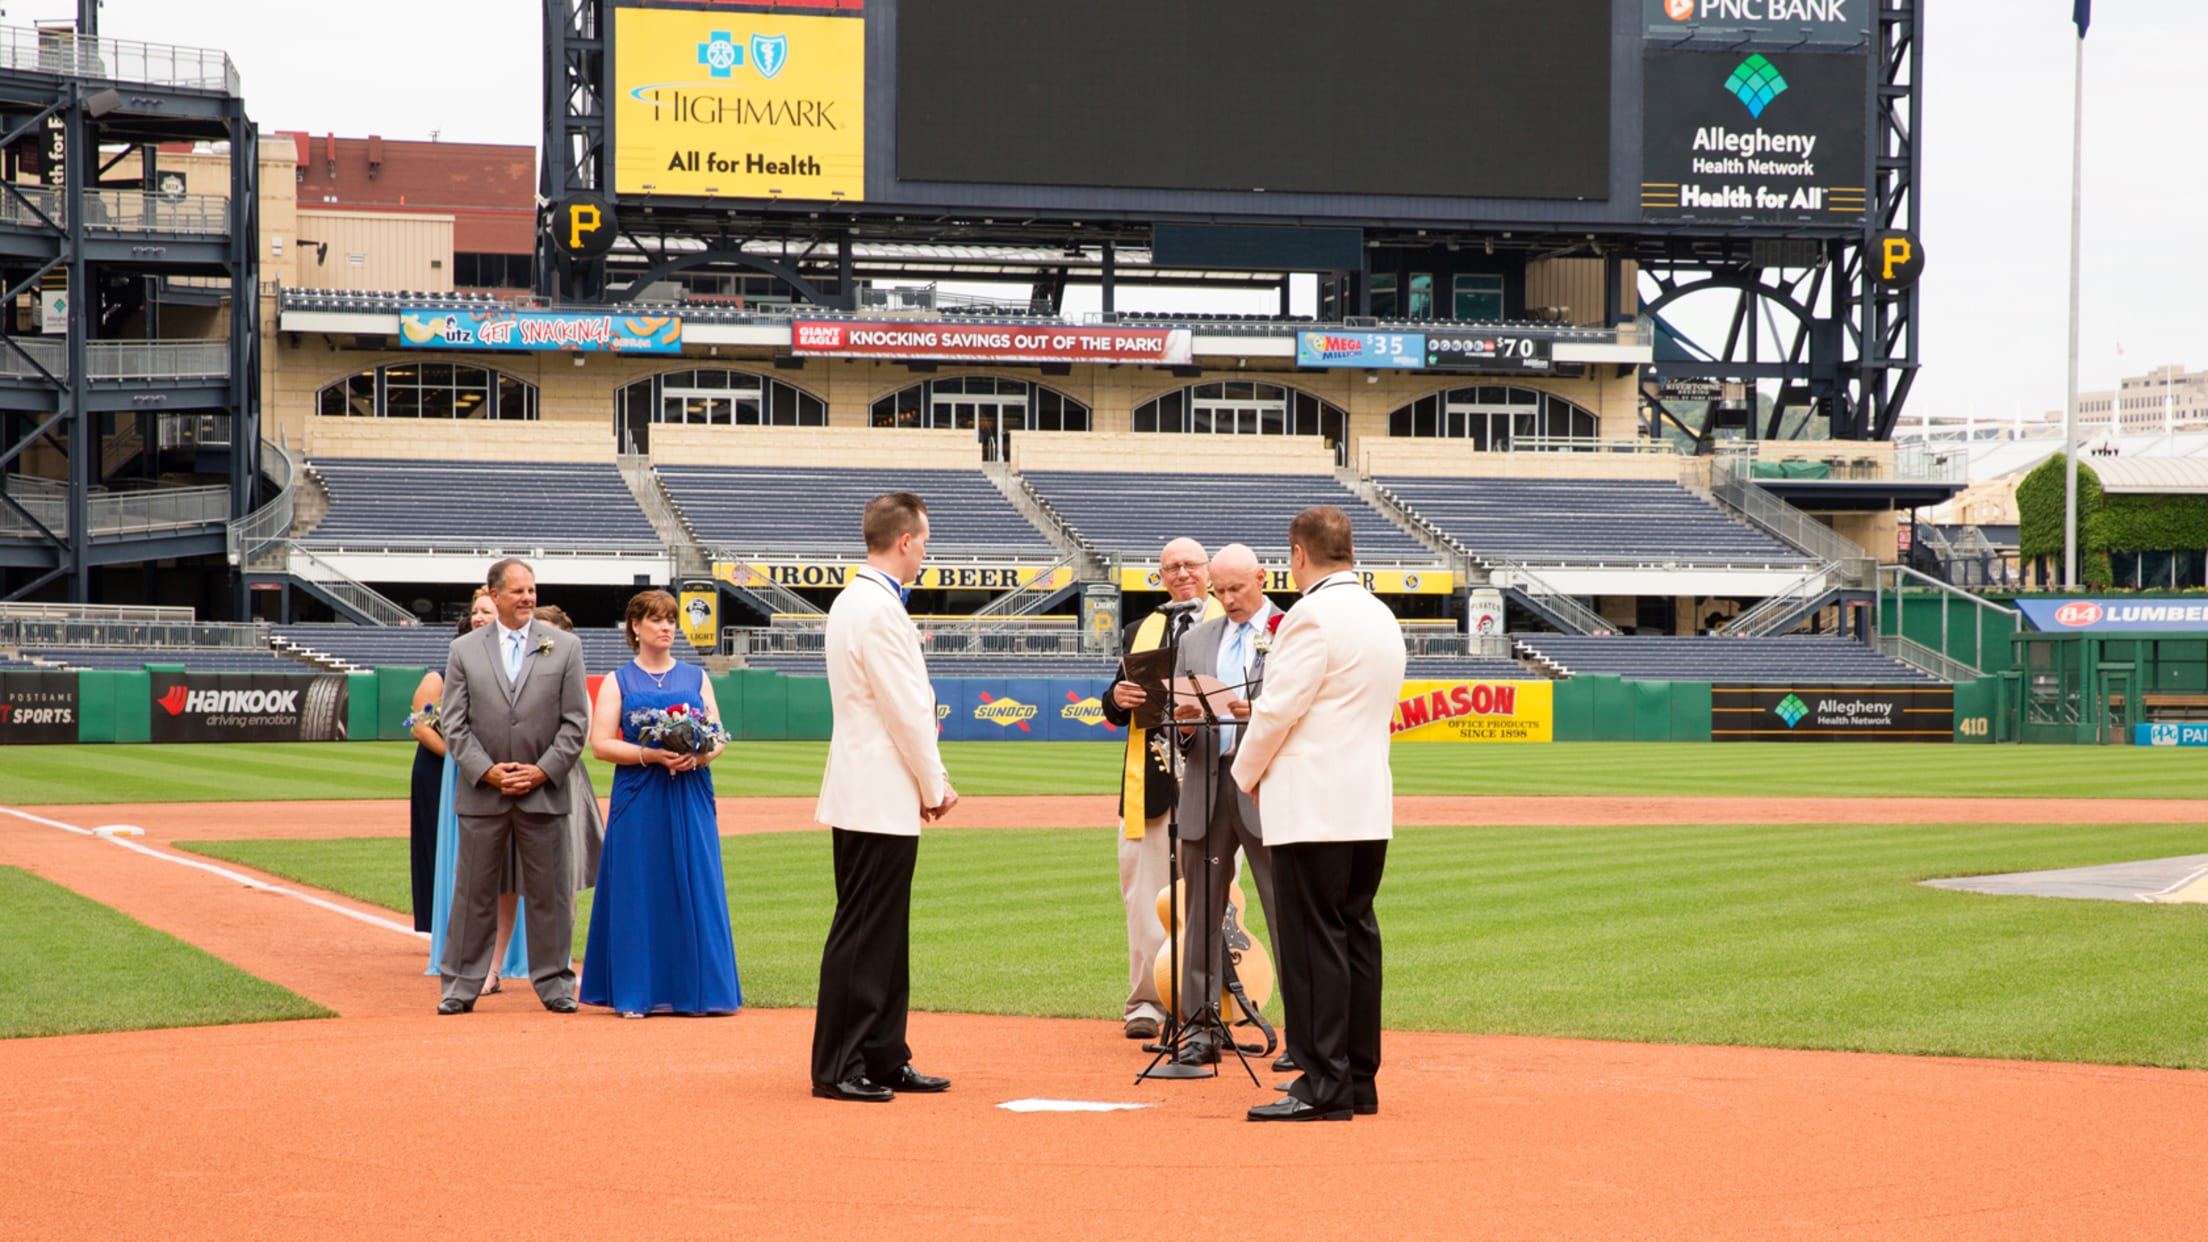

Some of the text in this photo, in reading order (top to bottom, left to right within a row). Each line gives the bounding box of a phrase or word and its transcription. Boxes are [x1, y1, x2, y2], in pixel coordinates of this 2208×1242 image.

[1701, 0, 1847, 22] PNC BANK
[654, 90, 837, 130] HIGHMARK
[48, 132, 65, 161] for
[1692, 127, 1816, 159] Allegheny
[667, 151, 821, 176] All for Health
[1692, 158, 1814, 175] Health Network
[1681, 185, 1752, 208] Health
[1755, 187, 1788, 209] for
[570, 204, 602, 248] P
[1883, 238, 1911, 279] P
[478, 320, 516, 344] GET
[519, 316, 611, 344] SNACKING!
[800, 327, 840, 335] GIANT
[800, 336, 840, 345] EAGLE
[850, 331, 1162, 351] KNOCKING SAVINGS OUT OF THE PARK!
[1325, 335, 1362, 351] MEGA
[768, 566, 846, 585] IRON
[938, 569, 1021, 588] BEER
[2060, 607, 2097, 622] 84
[9, 693, 72, 702] POSTGAME
[13, 708, 72, 724] SPORTS
[976, 706, 1035, 718] SUNOCO
[1063, 706, 1106, 718] SUNO
[1817, 700, 1892, 716] Allegheny
[206, 713, 296, 728] driving emotion
[1817, 716, 1891, 725] Health Network
[1960, 718, 1988, 735] 410
[1460, 730, 1527, 738] SINCE 1898
